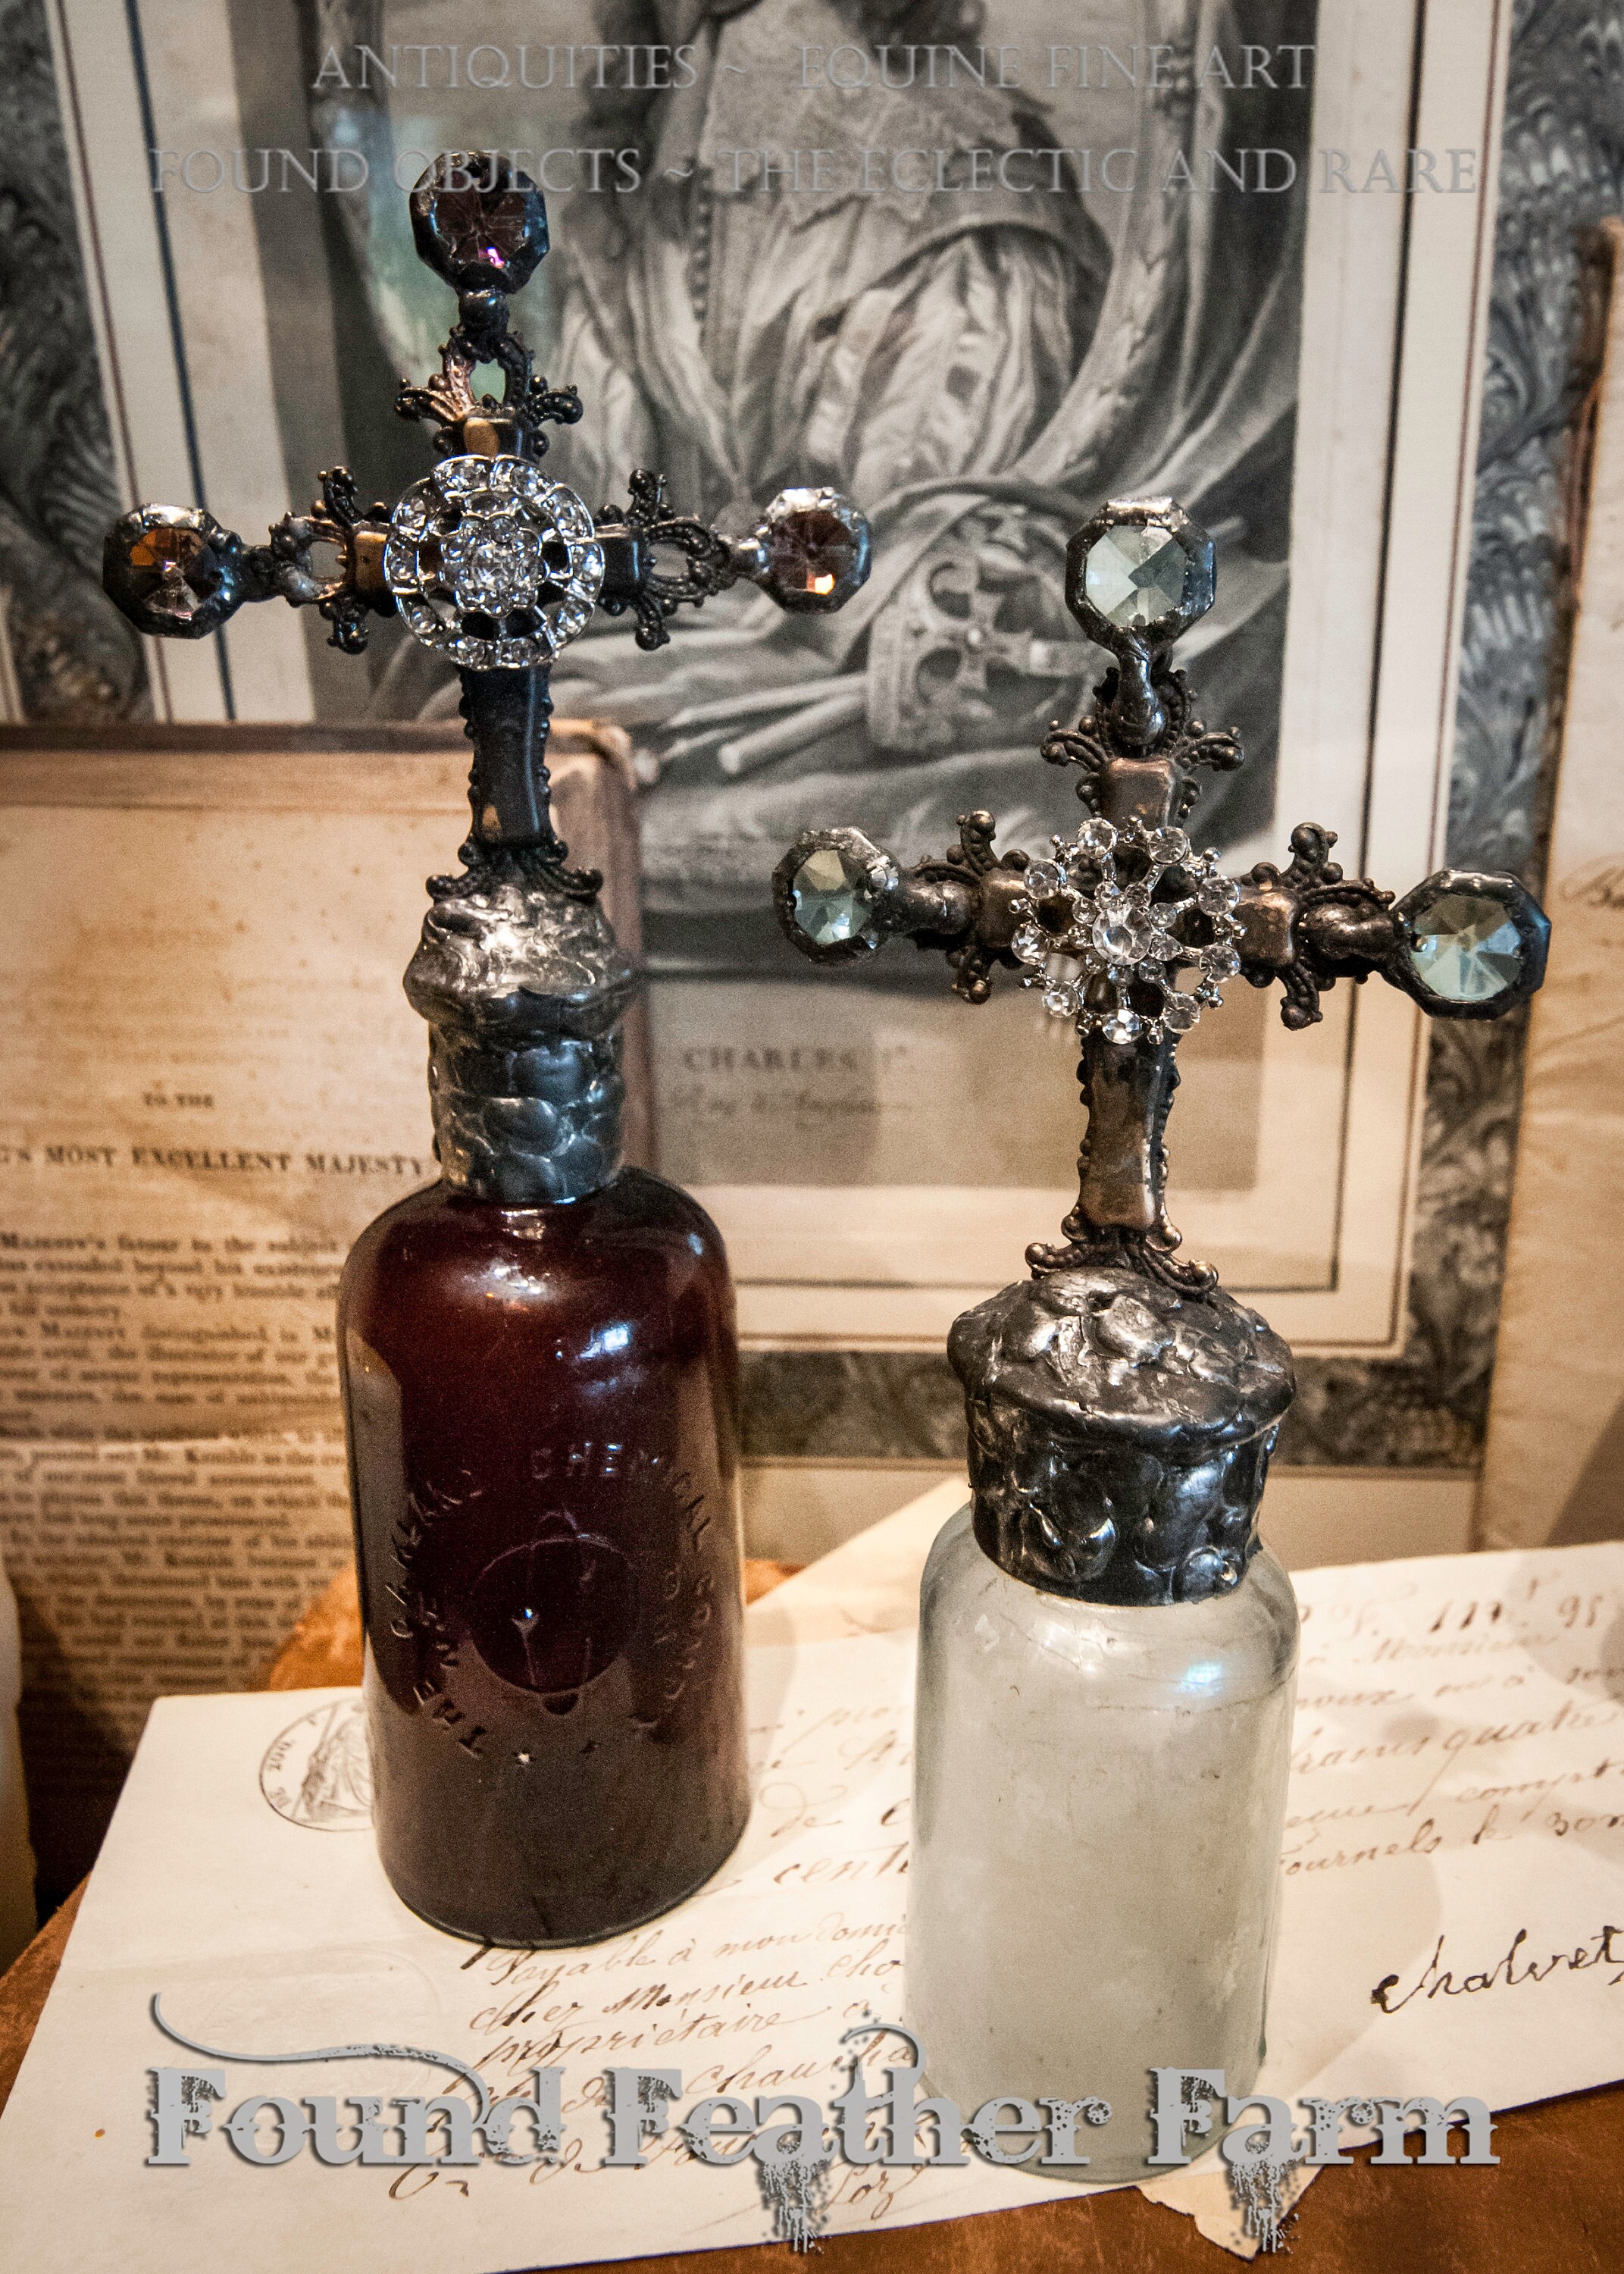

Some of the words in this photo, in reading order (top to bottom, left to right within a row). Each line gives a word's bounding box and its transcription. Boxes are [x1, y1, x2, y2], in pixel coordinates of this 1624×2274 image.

[44, 1144, 117, 1167] MOST
[130, 1145, 292, 1173] EXCELLENT
[305, 1152, 424, 1178] MAJESTY
